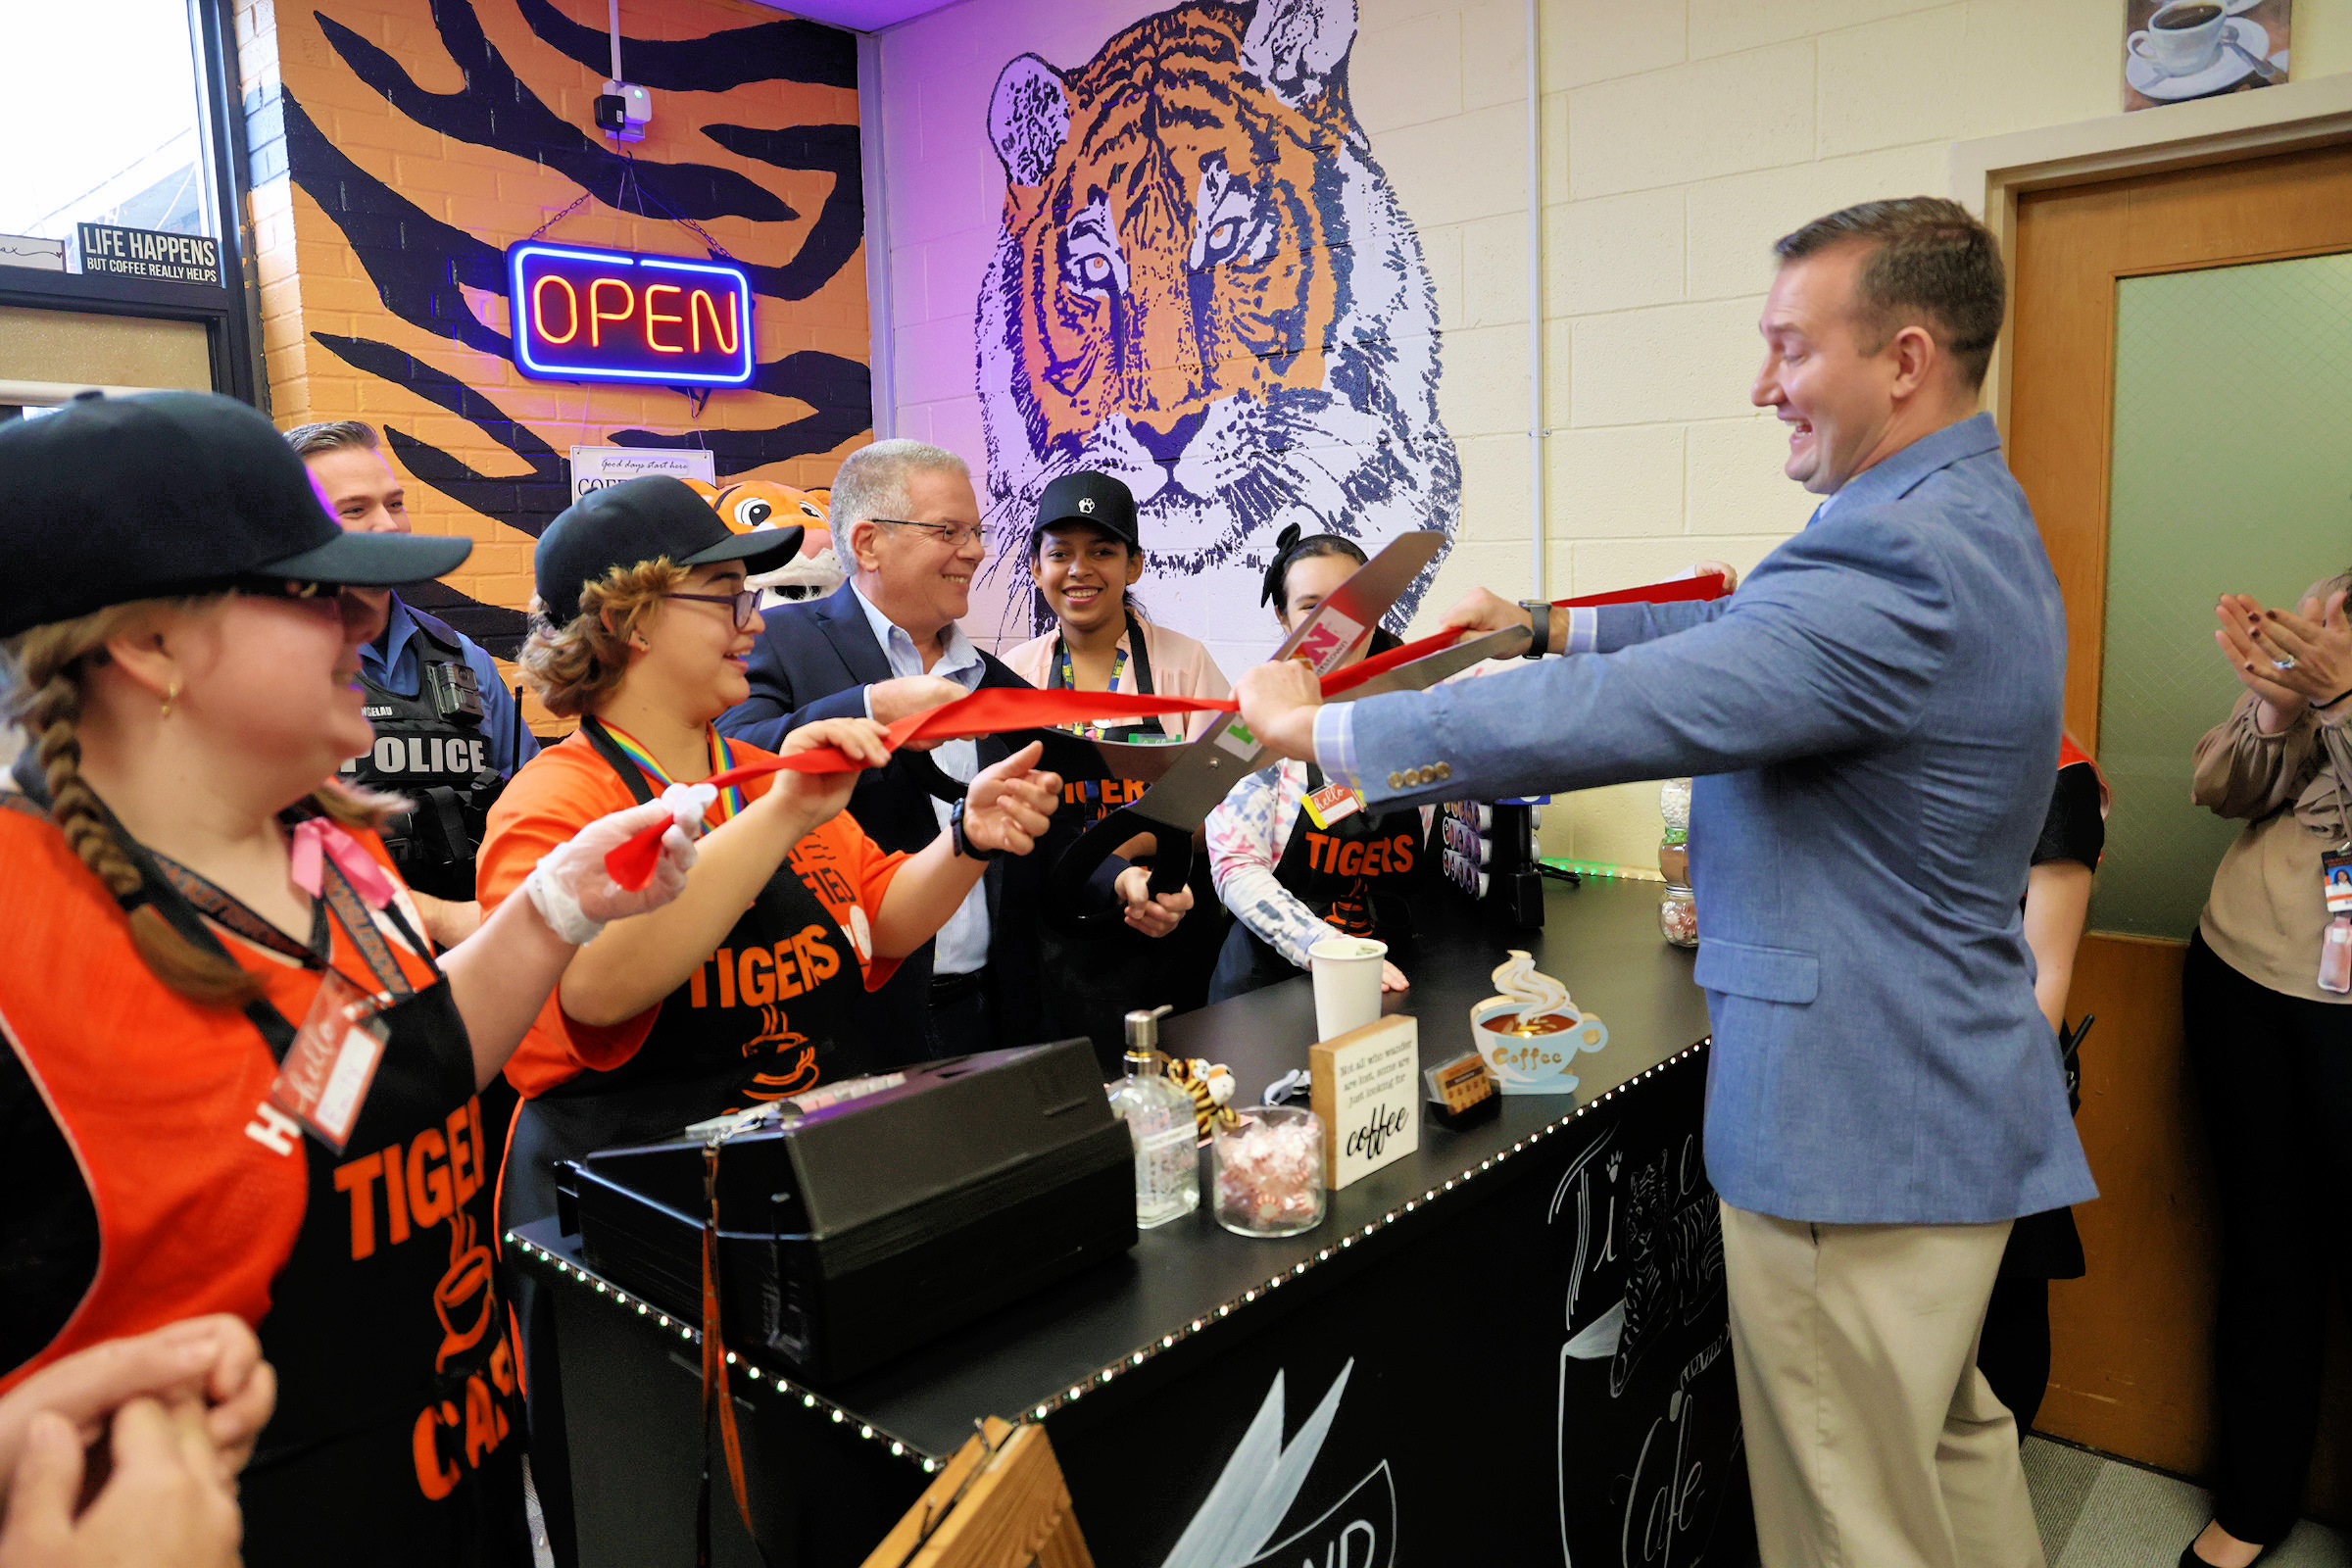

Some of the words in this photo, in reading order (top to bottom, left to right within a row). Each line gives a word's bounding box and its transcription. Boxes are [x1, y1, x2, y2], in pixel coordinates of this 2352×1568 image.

[83, 226, 125, 258] LIFE
[128, 231, 216, 267] HAPPENS
[86, 257, 107, 271] BUT
[109, 259, 147, 276] COFFEE
[149, 264, 184, 280] REALLY
[186, 267, 217, 283] HELPS
[533, 274, 738, 355] OPEN
[601, 458, 623, 471] Good
[624, 460, 645, 473] days
[647, 461, 668, 469] start
[669, 461, 688, 469] here
[341, 736, 487, 773] OLICE
[1313, 786, 1345, 811] hello
[1305, 832, 1414, 876] TIGERS
[690, 923, 841, 1008] TIGERS
[1492, 1047, 1562, 1070] Coffee
[1347, 1102, 1409, 1160] coffee
